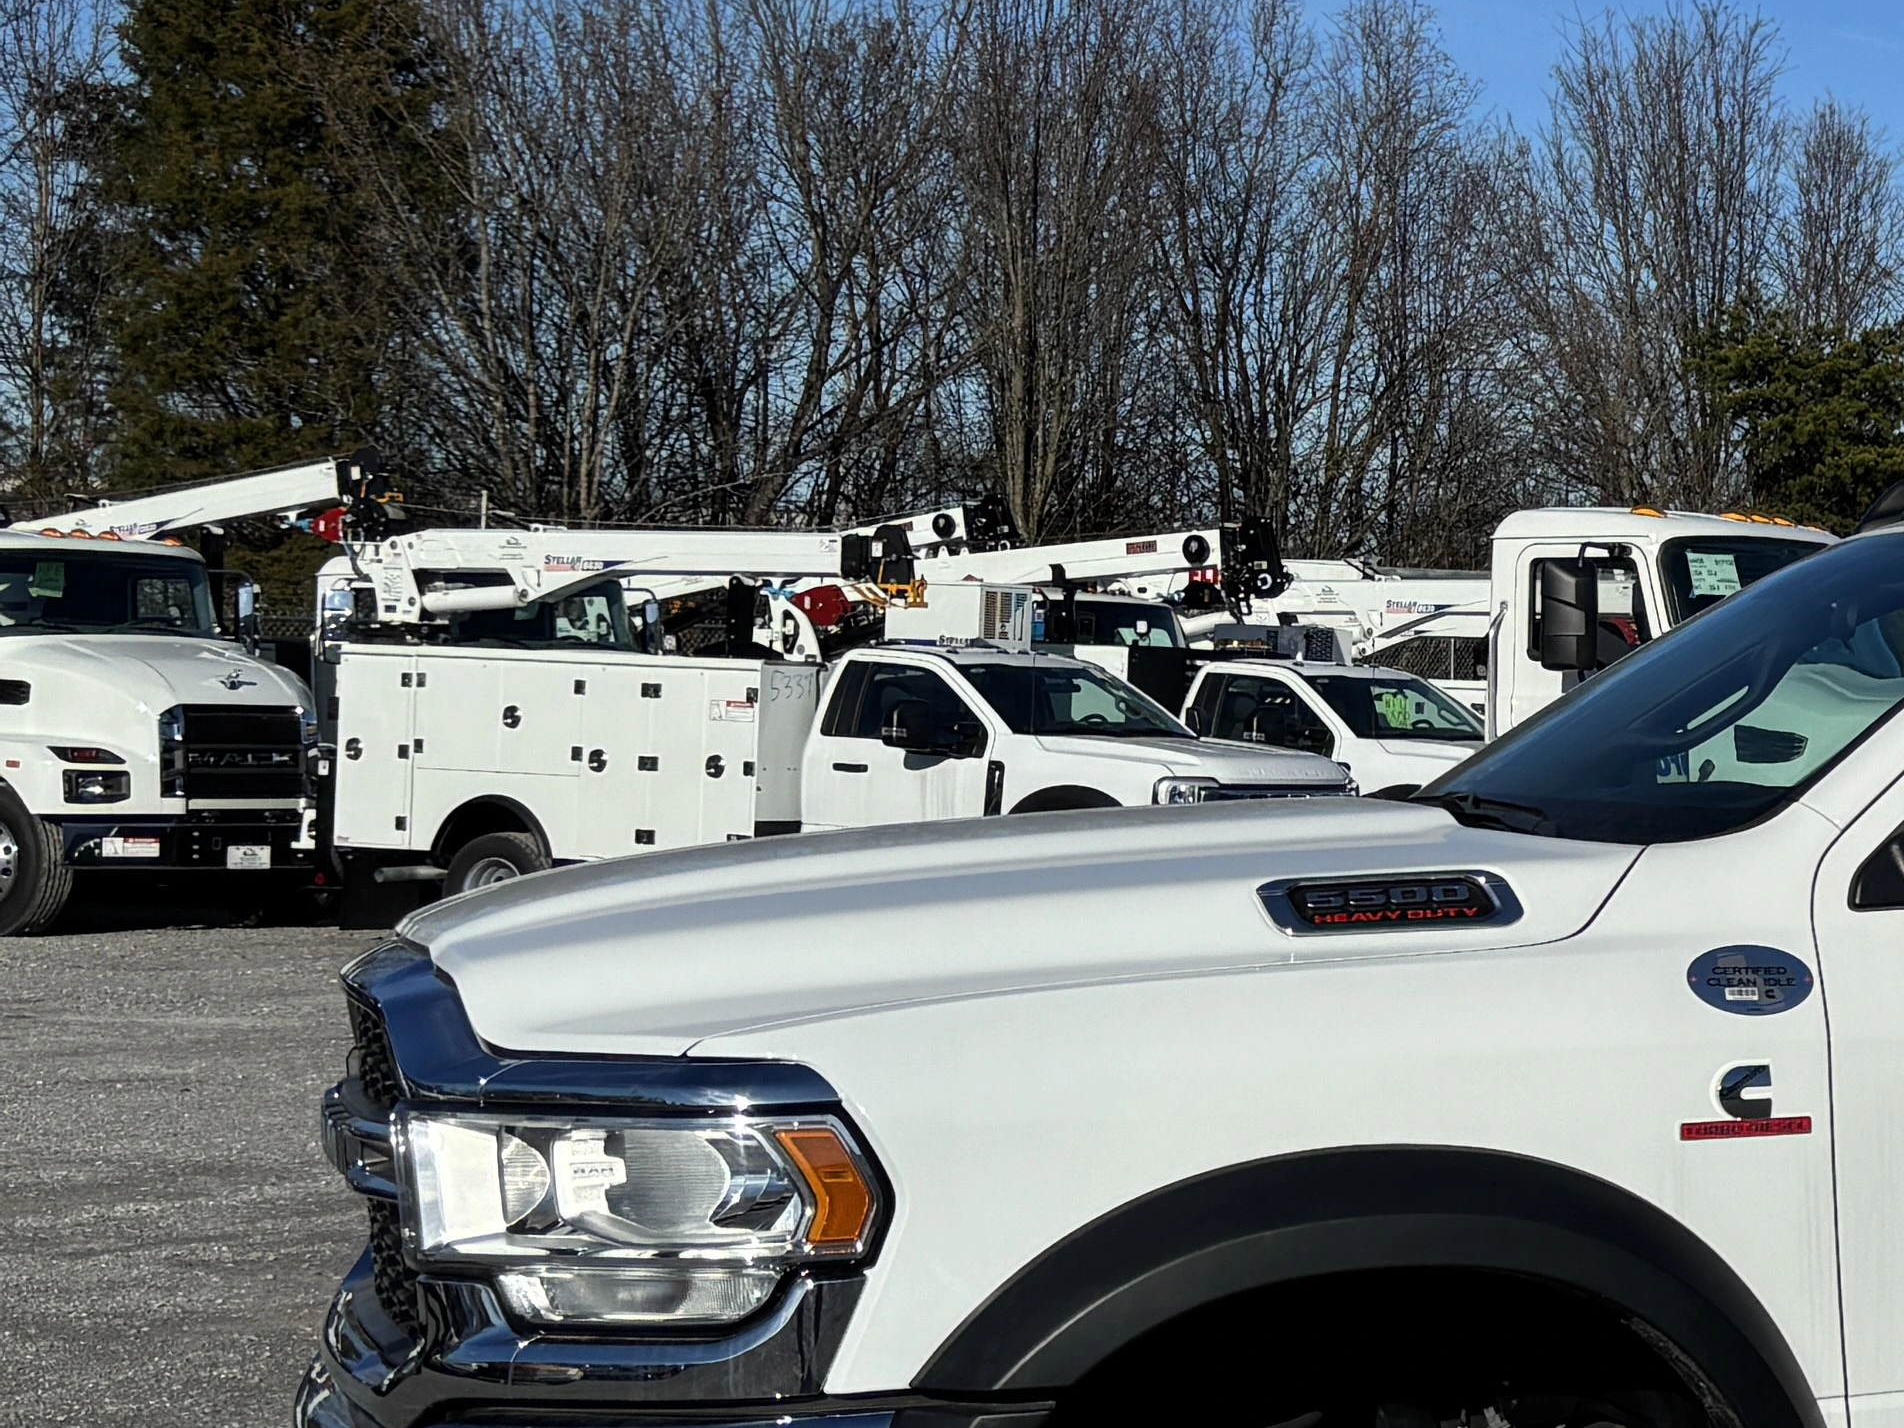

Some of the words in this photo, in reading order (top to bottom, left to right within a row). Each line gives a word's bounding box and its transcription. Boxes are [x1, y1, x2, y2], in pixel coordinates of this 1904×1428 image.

[1306, 884, 1470, 908] 5500
[1314, 909, 1401, 925] HEAVY
[1407, 907, 1479, 920] DUTY
[1711, 966, 1788, 975] CERTIFIED
[1706, 977, 1757, 987] CLEAN
[1763, 977, 1796, 987] IDLE
